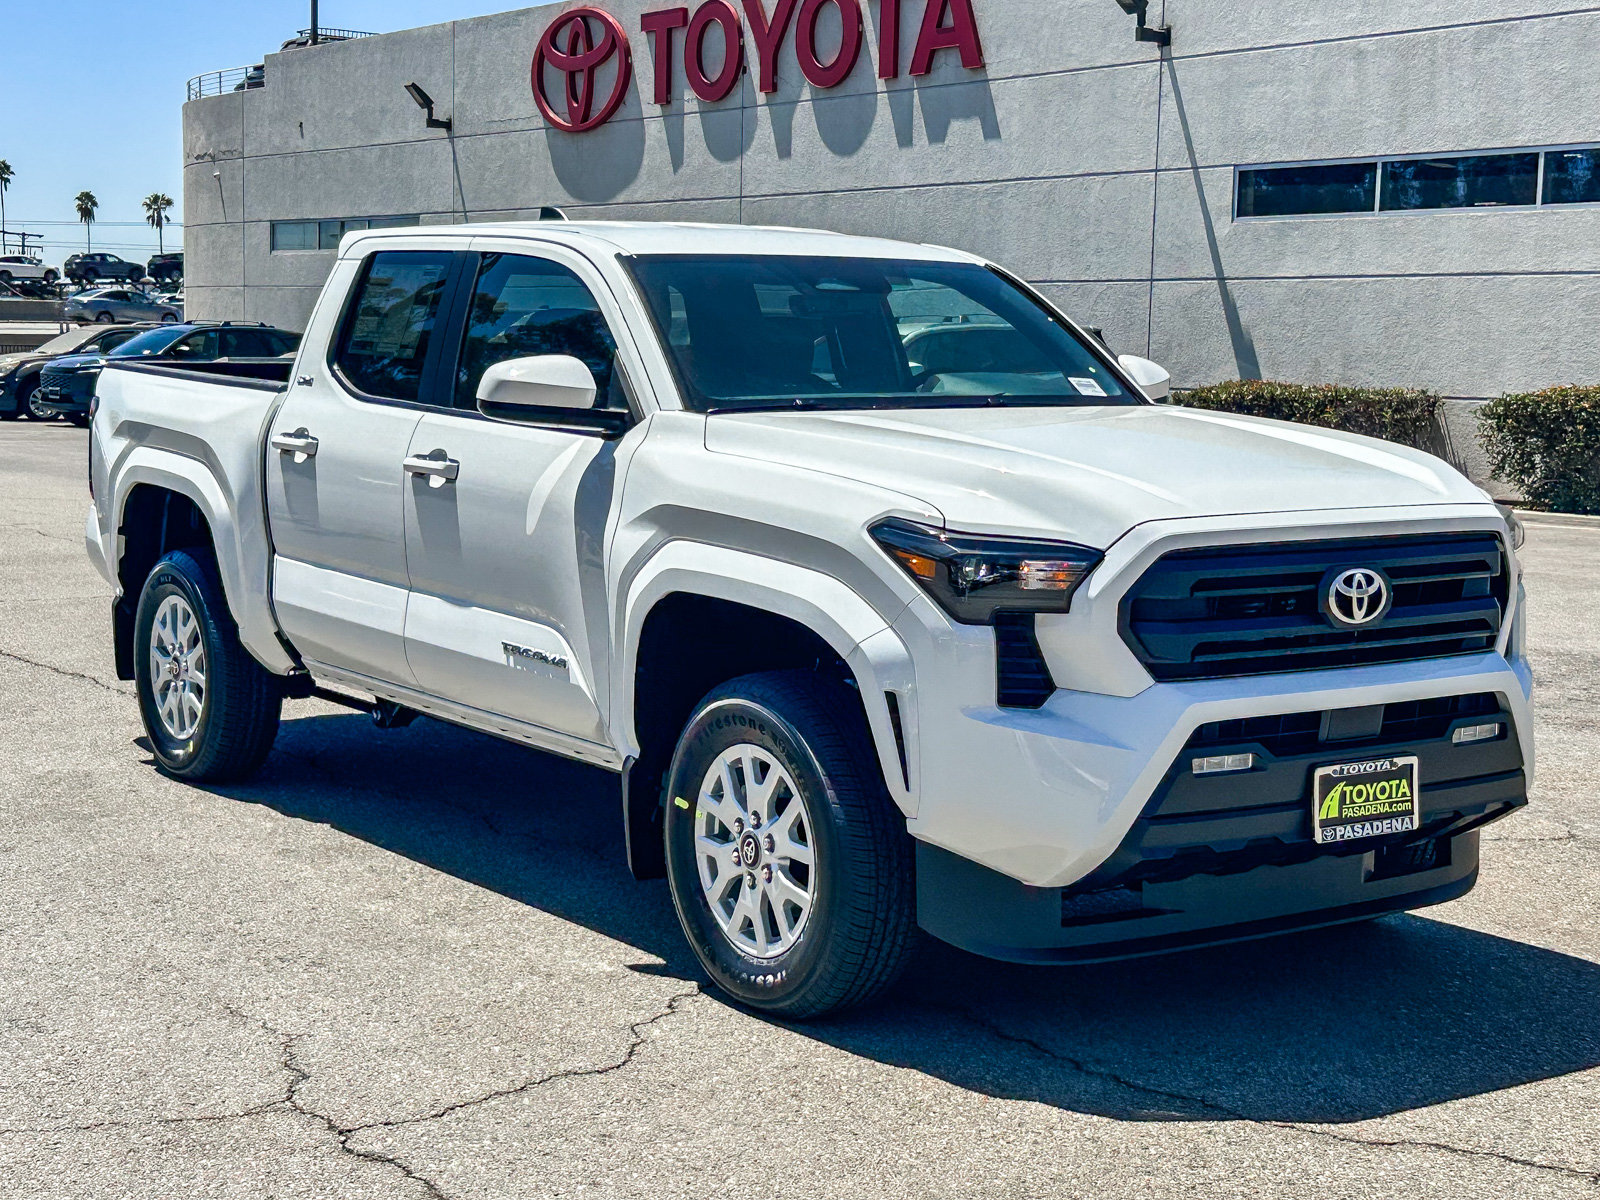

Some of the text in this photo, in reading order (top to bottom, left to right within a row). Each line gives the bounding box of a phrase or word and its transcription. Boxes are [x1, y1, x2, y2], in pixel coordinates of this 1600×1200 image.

[640, 0, 986, 106] TOYOTA
[1342, 760, 1391, 776] TOYOTA
[1343, 779, 1411, 805] TOYOTA
[1342, 801, 1412, 819] PASADENA.com
[1336, 817, 1413, 840] PASADENA
